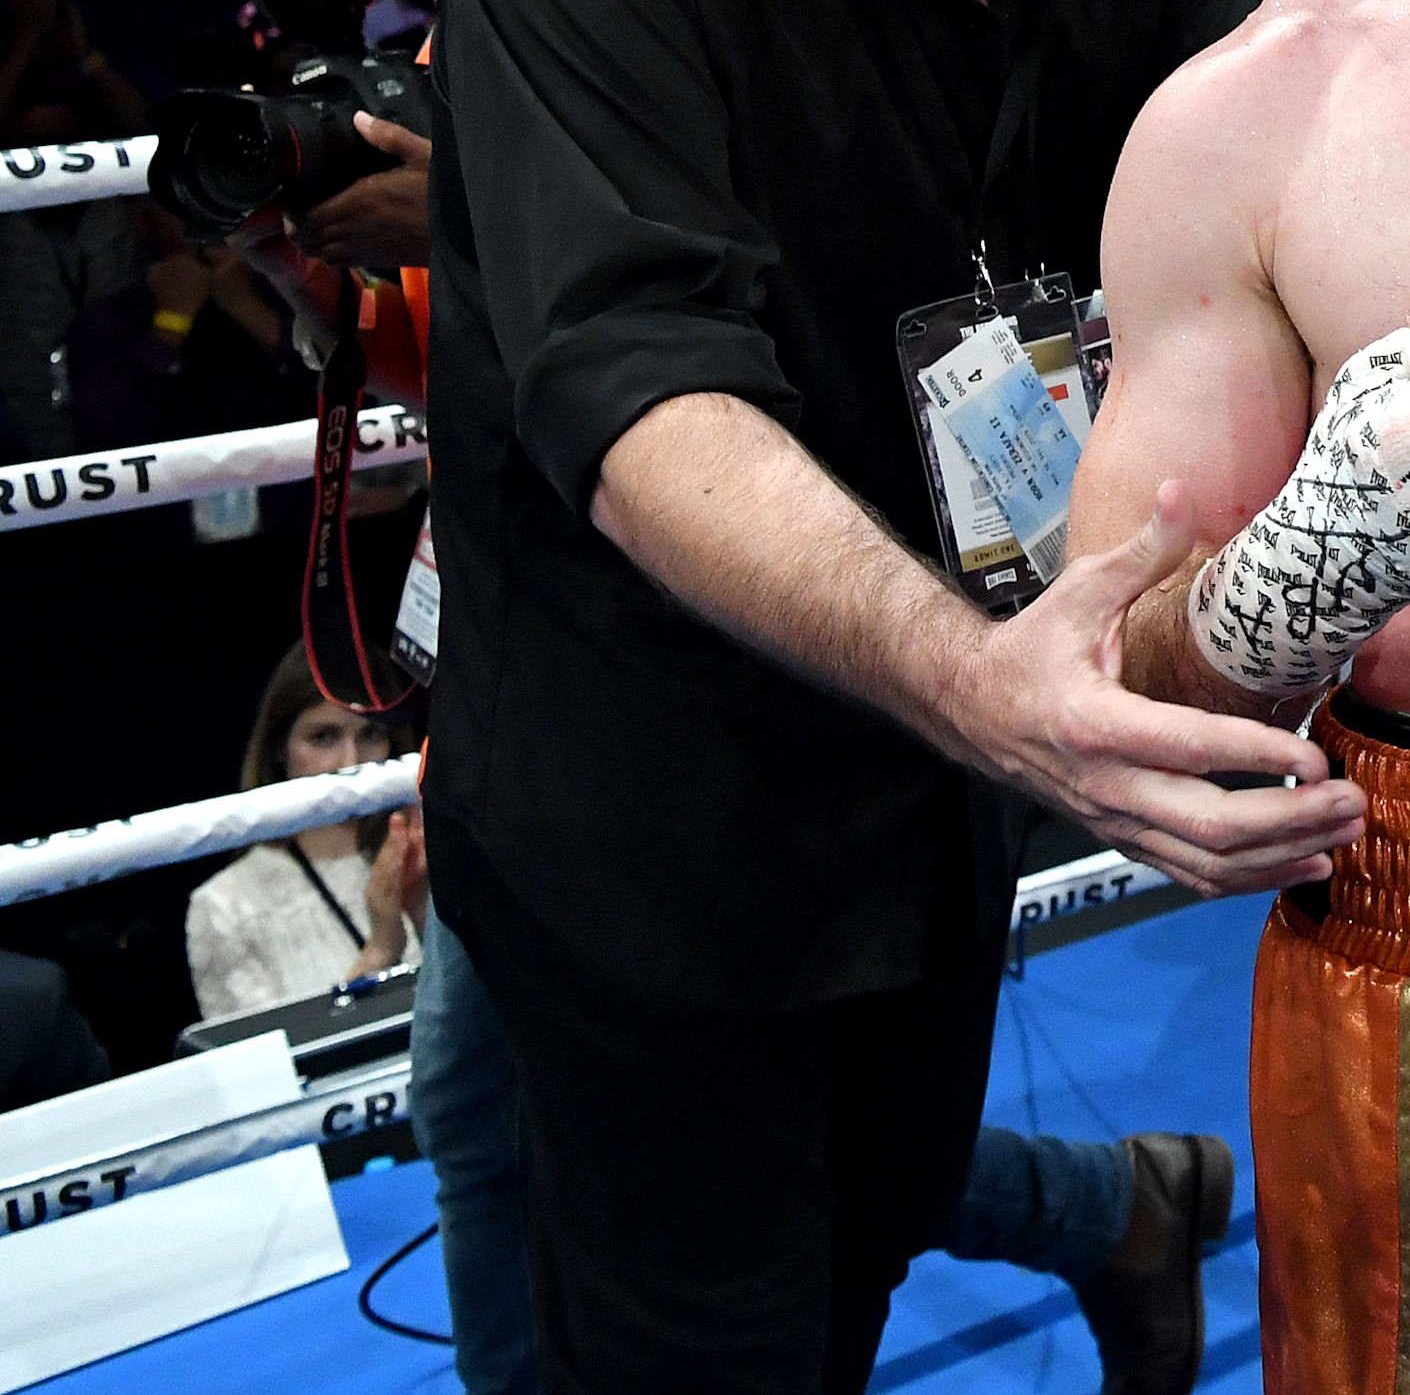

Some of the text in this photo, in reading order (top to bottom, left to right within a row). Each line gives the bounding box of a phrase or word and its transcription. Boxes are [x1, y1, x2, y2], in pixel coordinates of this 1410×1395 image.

[1369, 351, 1403, 369] EVERLAST
[945, 368, 967, 397] DOOR
[965, 366, 986, 385] 4
[322, 405, 347, 473] EOS
[997, 430, 1023, 466] ZERAFA
